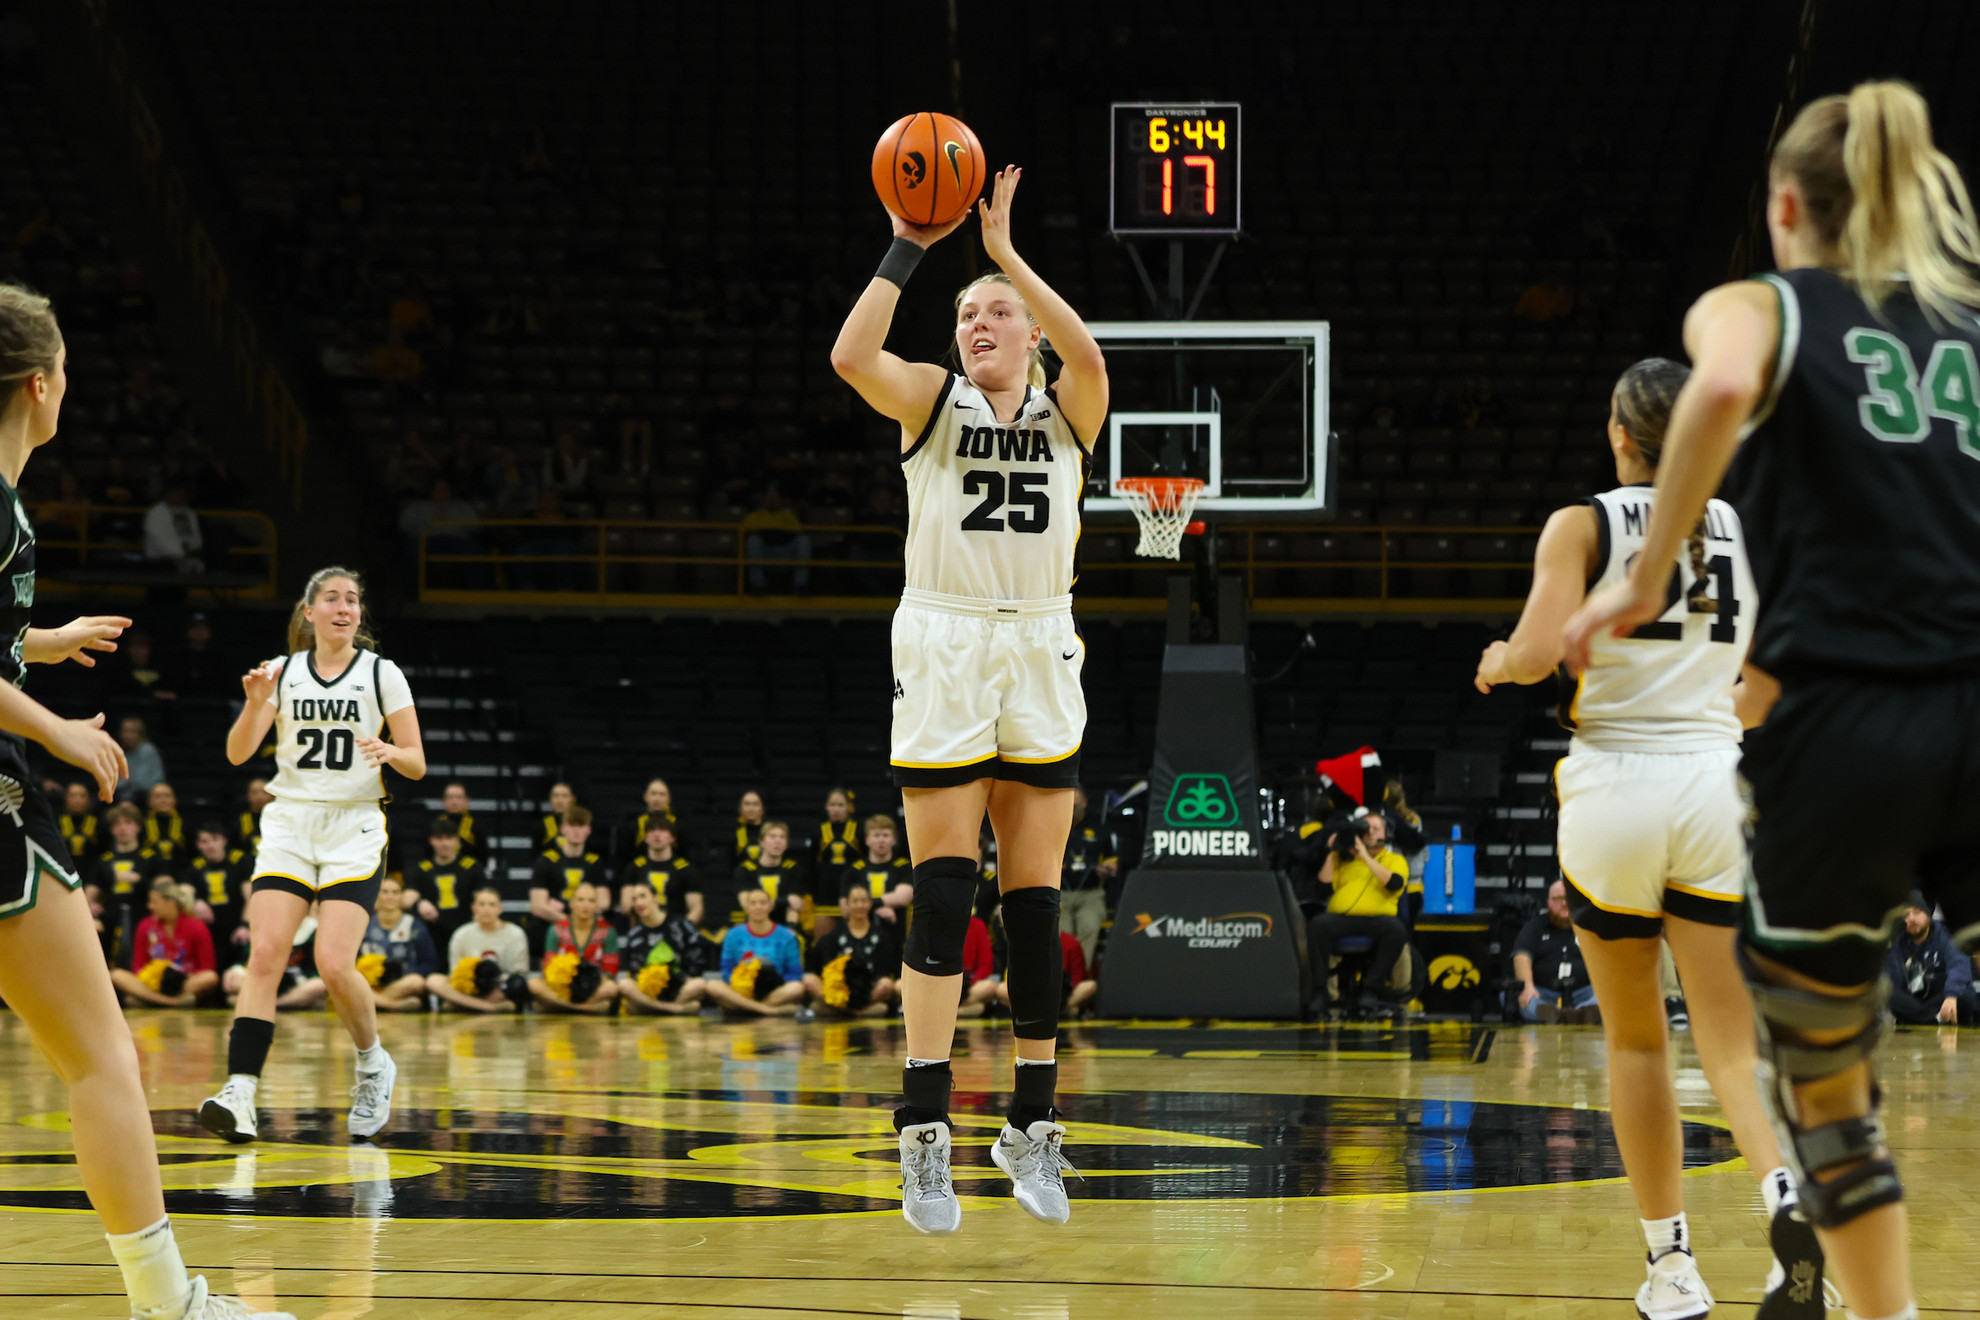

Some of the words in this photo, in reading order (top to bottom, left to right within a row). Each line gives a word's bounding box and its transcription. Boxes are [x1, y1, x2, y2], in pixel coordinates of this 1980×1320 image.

[1149, 117, 1226, 153] 6:44
[1162, 155, 1215, 216] 17
[1843, 326, 1980, 461] 34
[956, 424, 1054, 462] IOWA
[961, 470, 1050, 533] 25
[293, 698, 361, 722] IOWA
[296, 728, 354, 771] 20
[1152, 830, 1251, 857] PIONEER
[1167, 918, 1263, 938] Mediacom
[1188, 938, 1243, 948] COURT
